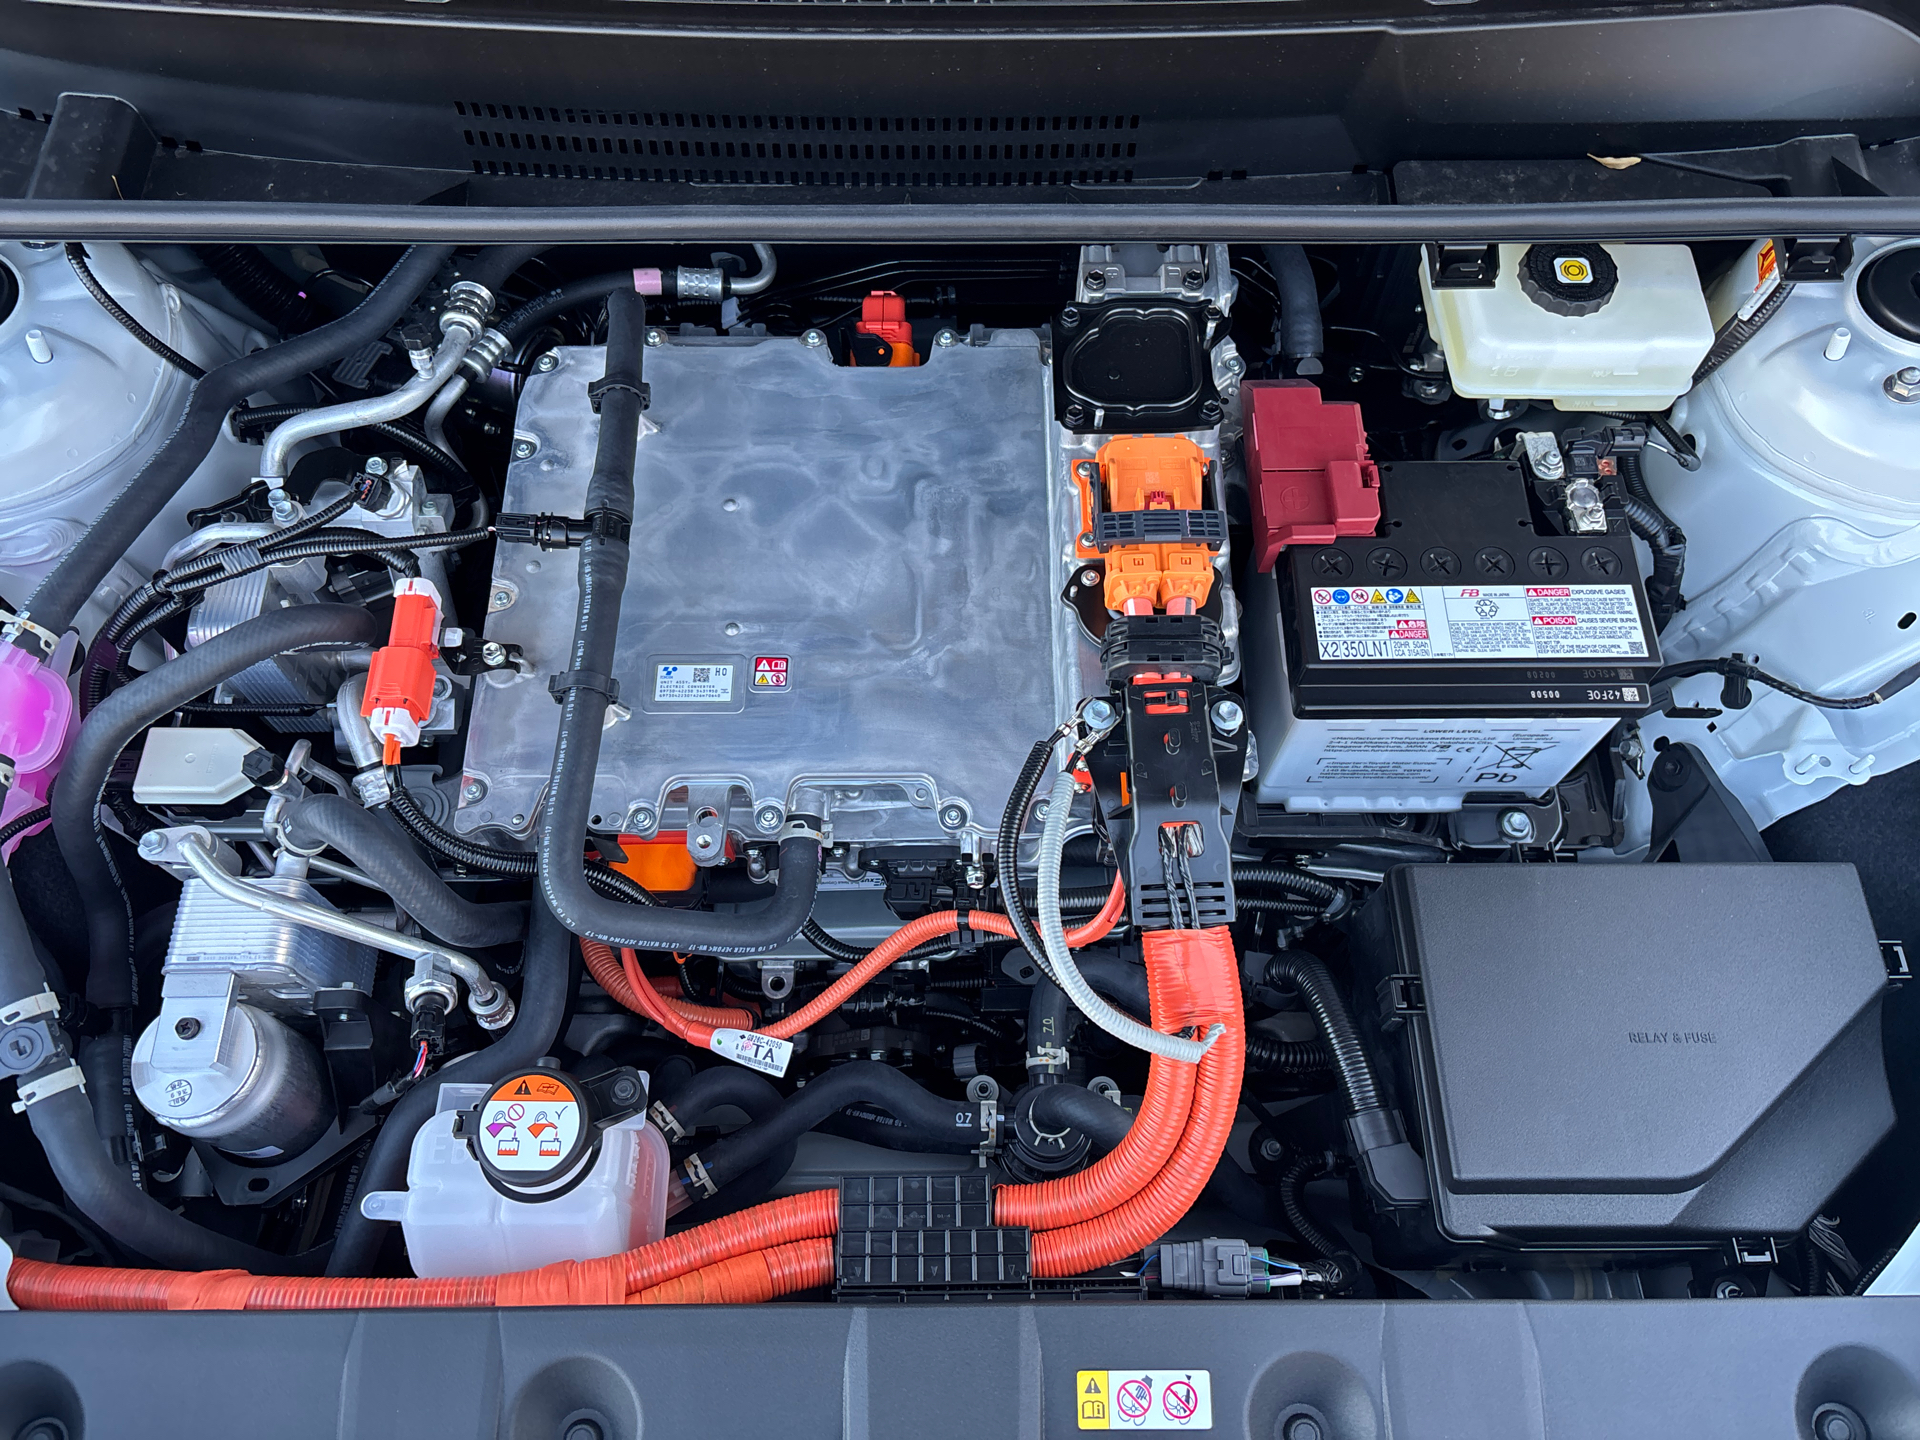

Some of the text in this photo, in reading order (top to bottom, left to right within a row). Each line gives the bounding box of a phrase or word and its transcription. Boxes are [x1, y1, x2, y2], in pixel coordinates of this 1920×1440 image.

[1537, 588, 1570, 596] DANGER
[1407, 620, 1426, 629] 危険
[1543, 617, 1576, 625] POISON
[1399, 630, 1428, 639] DANGER
[1320, 640, 1389, 658] X2 350LN1
[1394, 649, 1406, 657] CCA
[1474, 773, 1518, 783] Pb
[543, 878, 556, 906] WATER
[1628, 1031, 1717, 1044] RELAY & FUSE
[752, 1043, 774, 1063] TA
